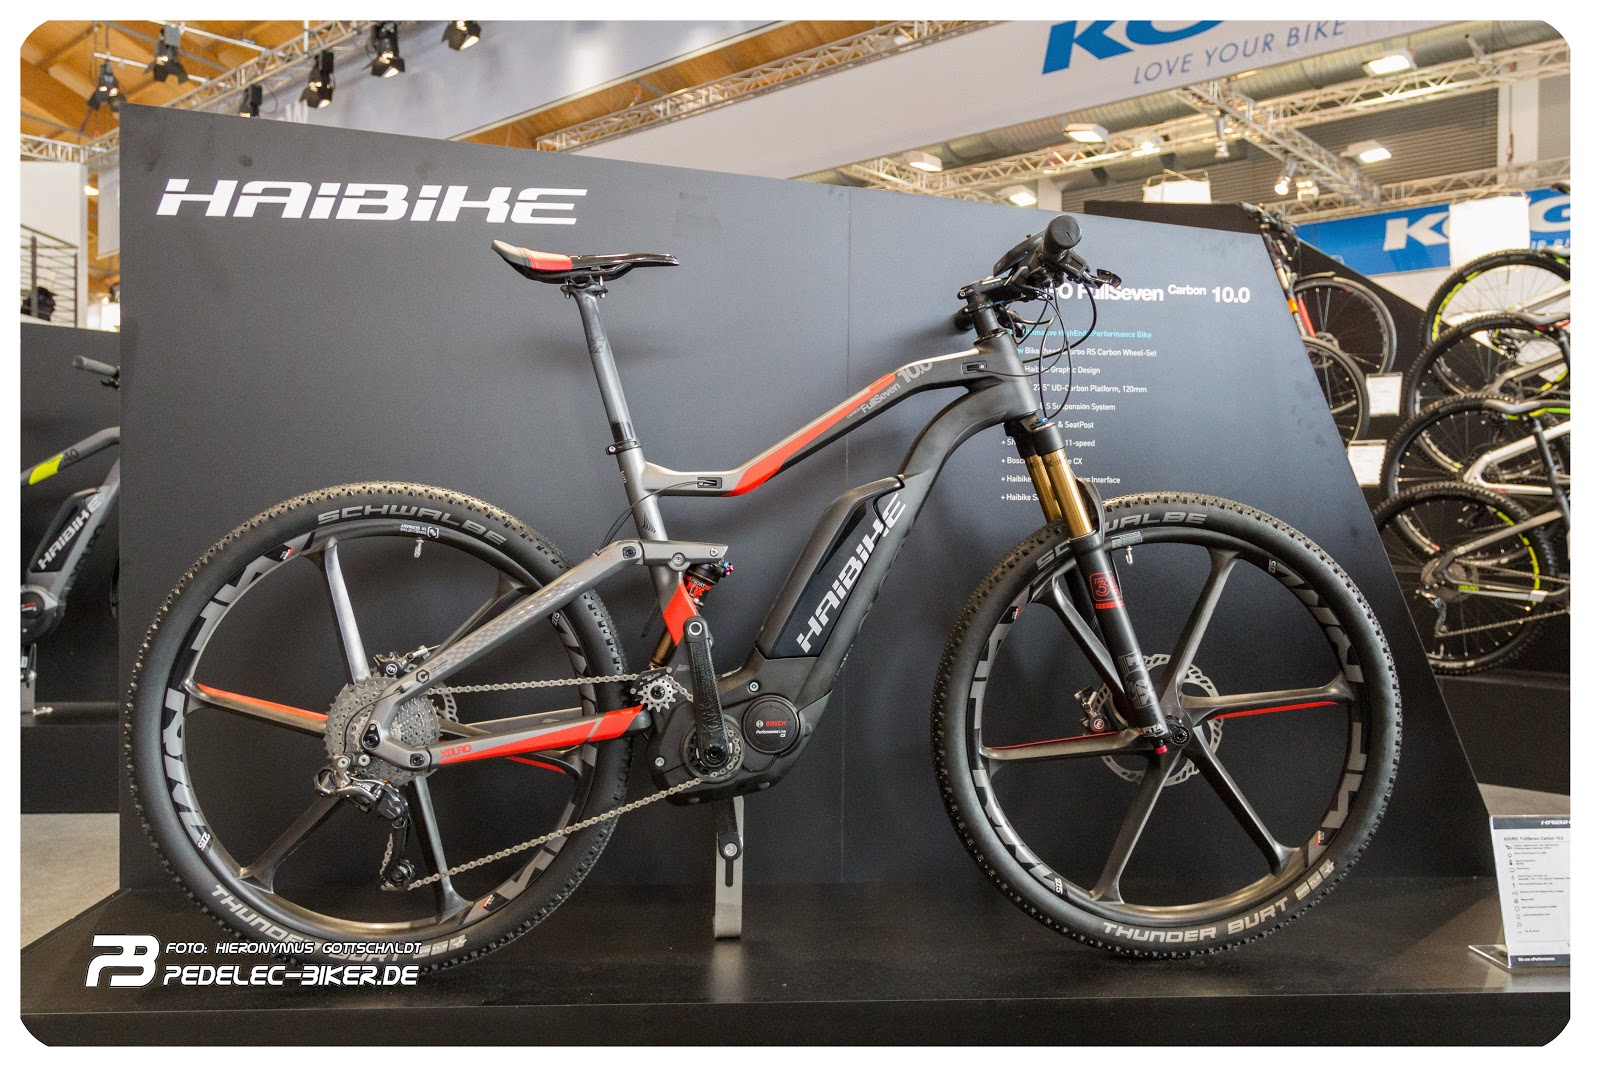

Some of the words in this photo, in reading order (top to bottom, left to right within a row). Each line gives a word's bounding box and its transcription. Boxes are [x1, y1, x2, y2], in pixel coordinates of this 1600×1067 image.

[1133, 53, 1194, 85] LOVE
[1204, 33, 1275, 67] YOUR
[1286, 20, 1346, 48] BIKE
[156, 178, 587, 225] HAIBIKE
[1077, 283, 1164, 301] FullSeven
[1167, 284, 1207, 296] Carbon
[1211, 286, 1251, 303] 10.0
[1097, 348, 1121, 356] Carbon
[1122, 348, 1157, 357] Wheel-Set
[1050, 366, 1077, 375] Graphc
[1077, 366, 1101, 376] Design
[1090, 385, 1121, 394] Platform,
[1122, 385, 1147, 393] 120mm
[860, 382, 901, 414] FullSeven
[1091, 403, 1116, 412] System
[1057, 420, 1064, 428] &
[1064, 421, 1095, 429] SeatPost
[1065, 438, 1096, 448] 11-speed
[1073, 457, 1083, 465] CX
[1006, 475, 1032, 483] Haibike
[1091, 475, 1121, 484] Interface
[1006, 493, 1032, 501] Haibike
[317, 504, 507, 546] SCHWALBE
[37, 495, 102, 571] HAIBIKE
[1036, 511, 1208, 571] SCWALBE
[796, 492, 906, 654] HAIBIKE
[440, 743, 472, 758] XDURO
[1103, 921, 1217, 943] THUNDER
[1227, 897, 1288, 935] BURT
